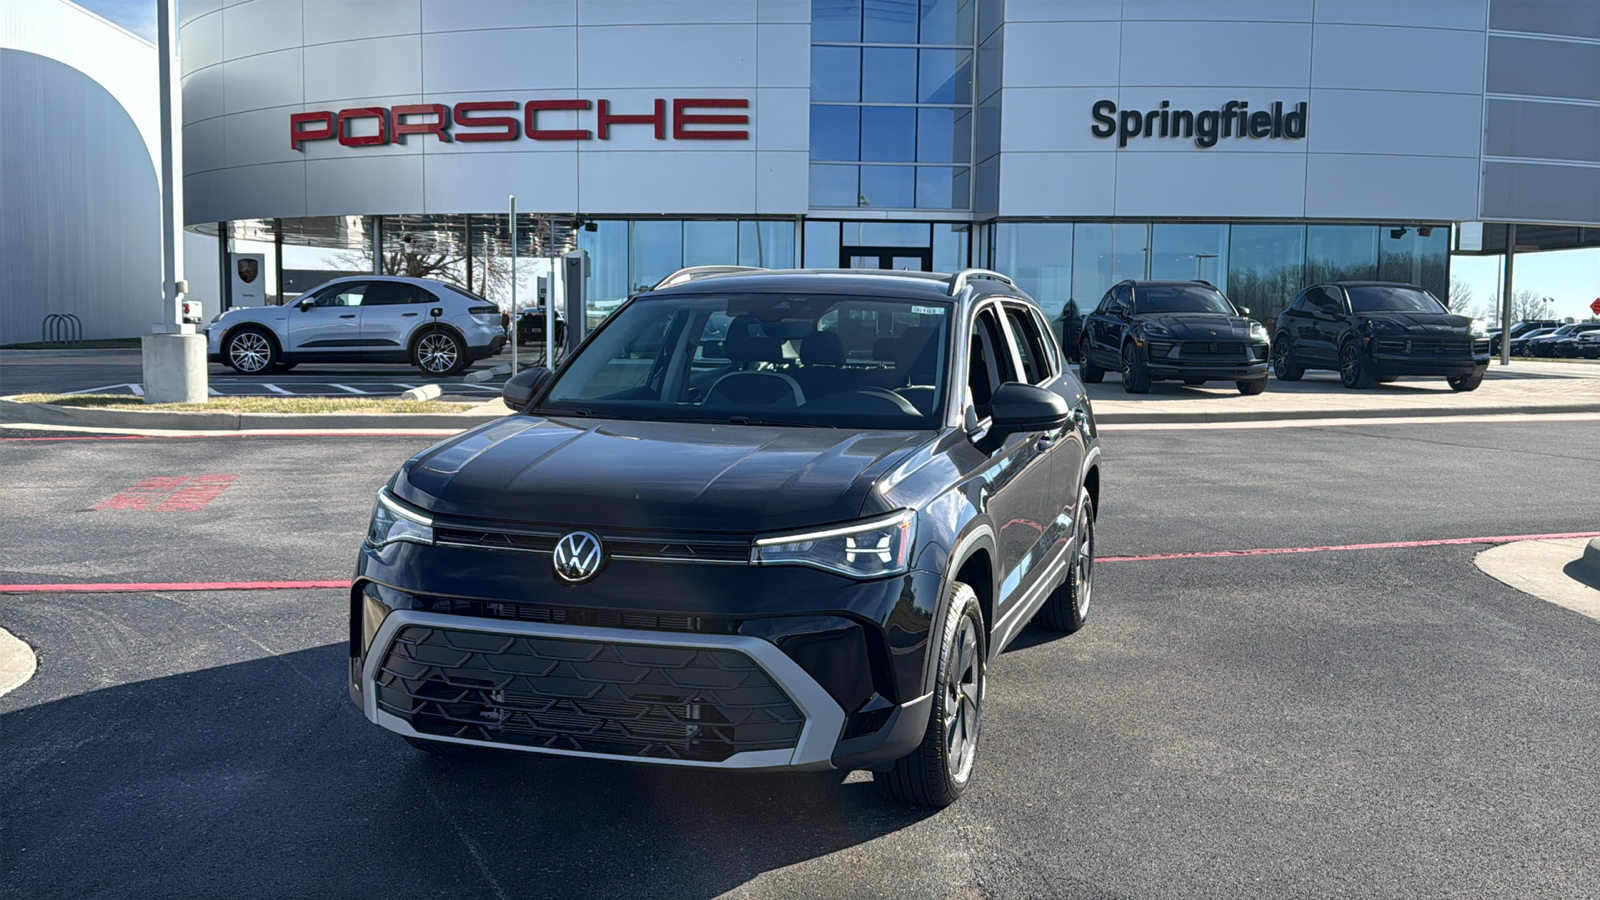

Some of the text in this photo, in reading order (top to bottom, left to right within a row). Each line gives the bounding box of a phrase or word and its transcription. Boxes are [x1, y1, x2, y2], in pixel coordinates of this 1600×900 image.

[290, 98, 749, 151] PORSCHE
[1091, 99, 1307, 148] Springfield
[555, 532, 600, 579] VW
